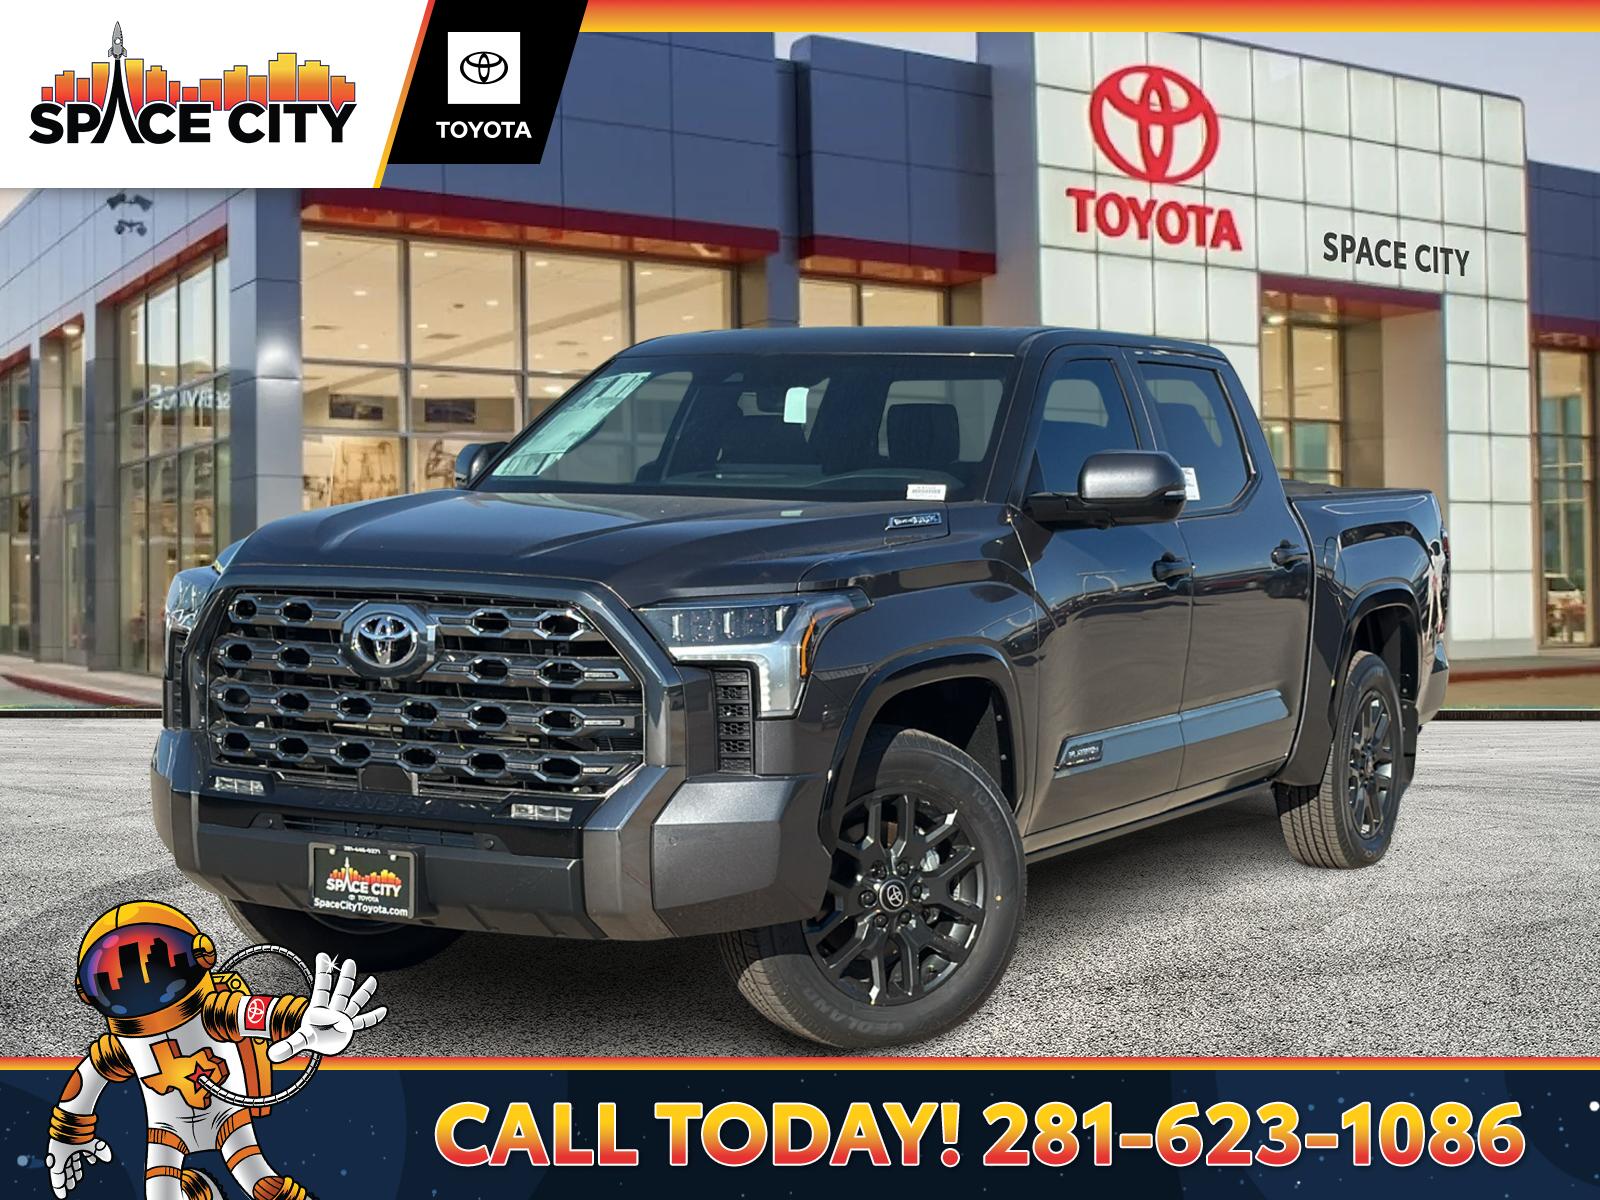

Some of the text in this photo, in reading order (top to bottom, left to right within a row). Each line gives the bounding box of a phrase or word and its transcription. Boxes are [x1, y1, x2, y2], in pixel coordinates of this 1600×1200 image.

[1066, 187, 1242, 252] TOYOTA
[1323, 231, 1470, 277] SPACE CITY
[371, 882, 402, 898] CITY
[313, 897, 408, 917] SpaceCityToyota.com
